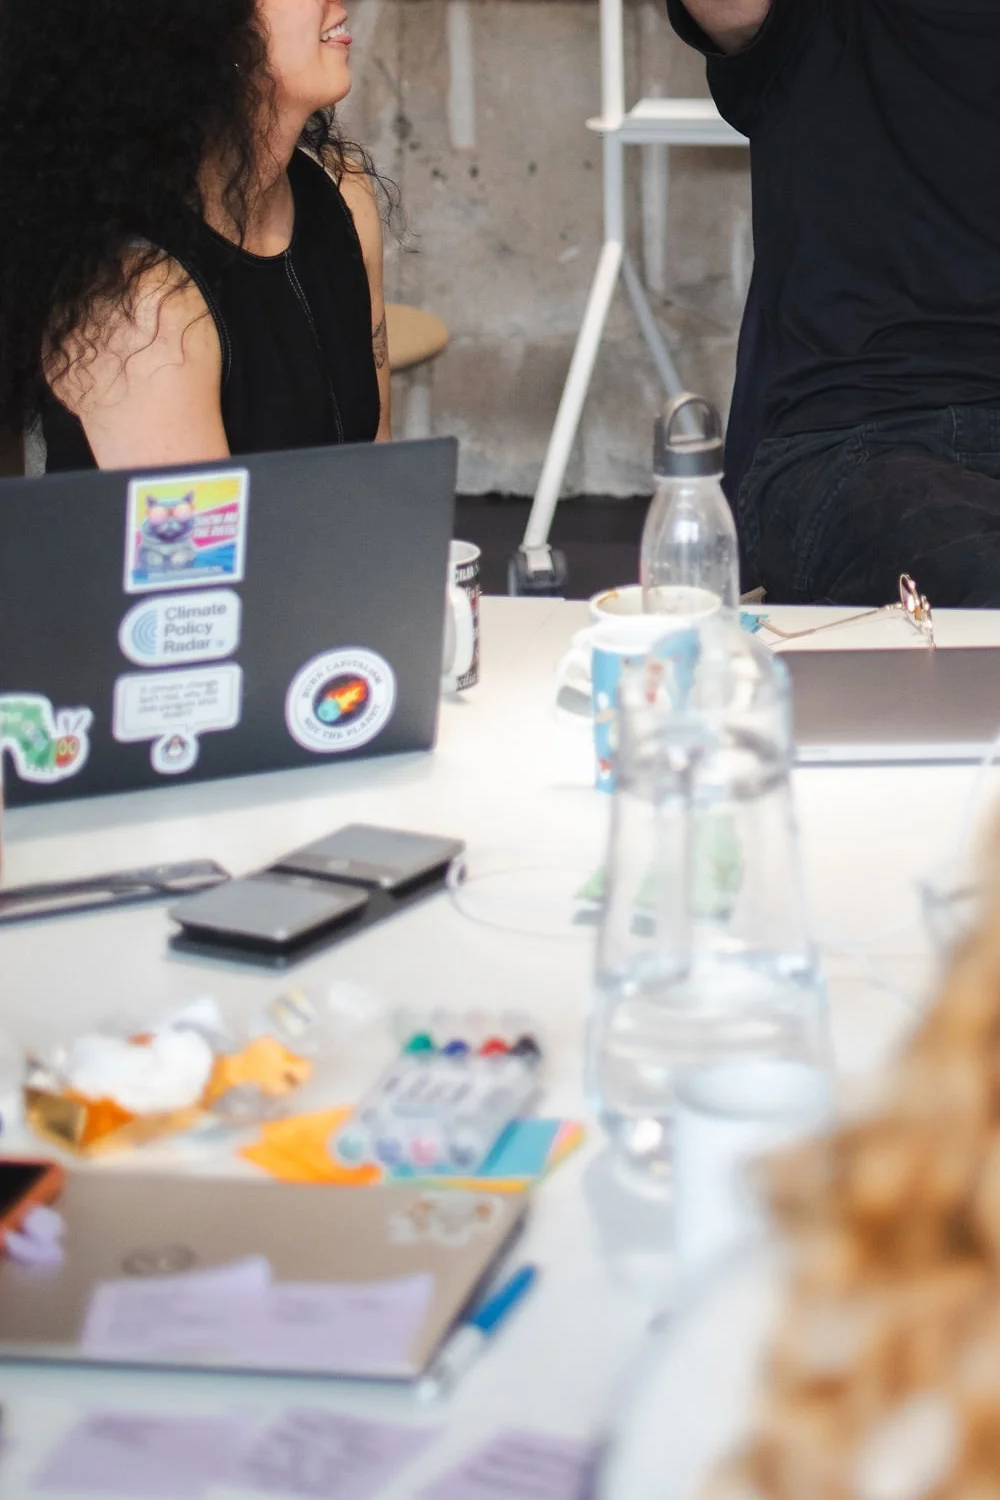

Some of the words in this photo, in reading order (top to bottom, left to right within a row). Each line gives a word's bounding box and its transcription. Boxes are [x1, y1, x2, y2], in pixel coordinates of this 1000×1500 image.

[165, 604, 228, 621] Climate
[164, 621, 214, 637] Policy
[163, 637, 211, 654] Radar
[302, 672, 324, 698] BURN
[326, 660, 382, 685] CAPITALISM
[322, 731, 344, 740] THE
[346, 703, 381, 737] PLANET
